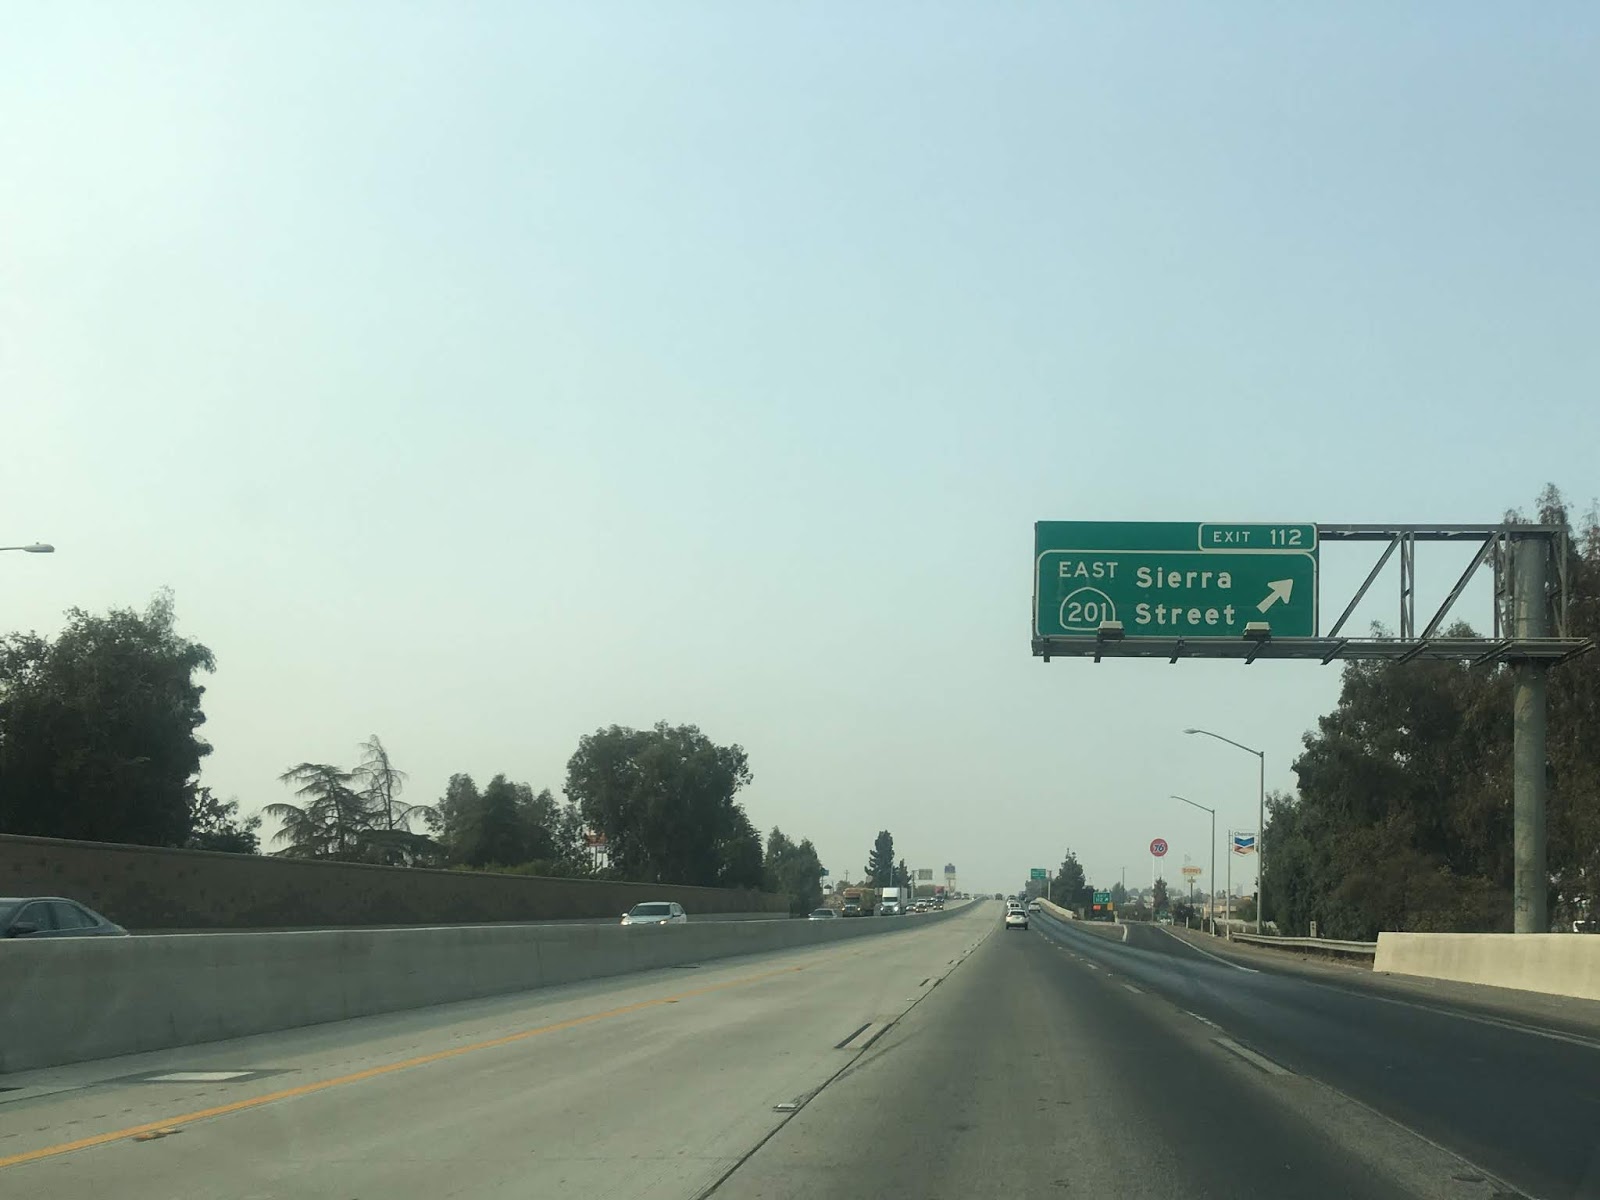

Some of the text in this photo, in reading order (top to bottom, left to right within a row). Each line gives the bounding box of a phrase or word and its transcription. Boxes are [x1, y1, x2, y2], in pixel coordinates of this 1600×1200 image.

[1213, 529, 1302, 545] EXIT 112
[1059, 561, 1118, 578] EAST
[1136, 566, 1232, 589] Sierra
[1067, 602, 1107, 622] 201
[1135, 603, 1236, 625] Street
[1153, 843, 1165, 852] 76
